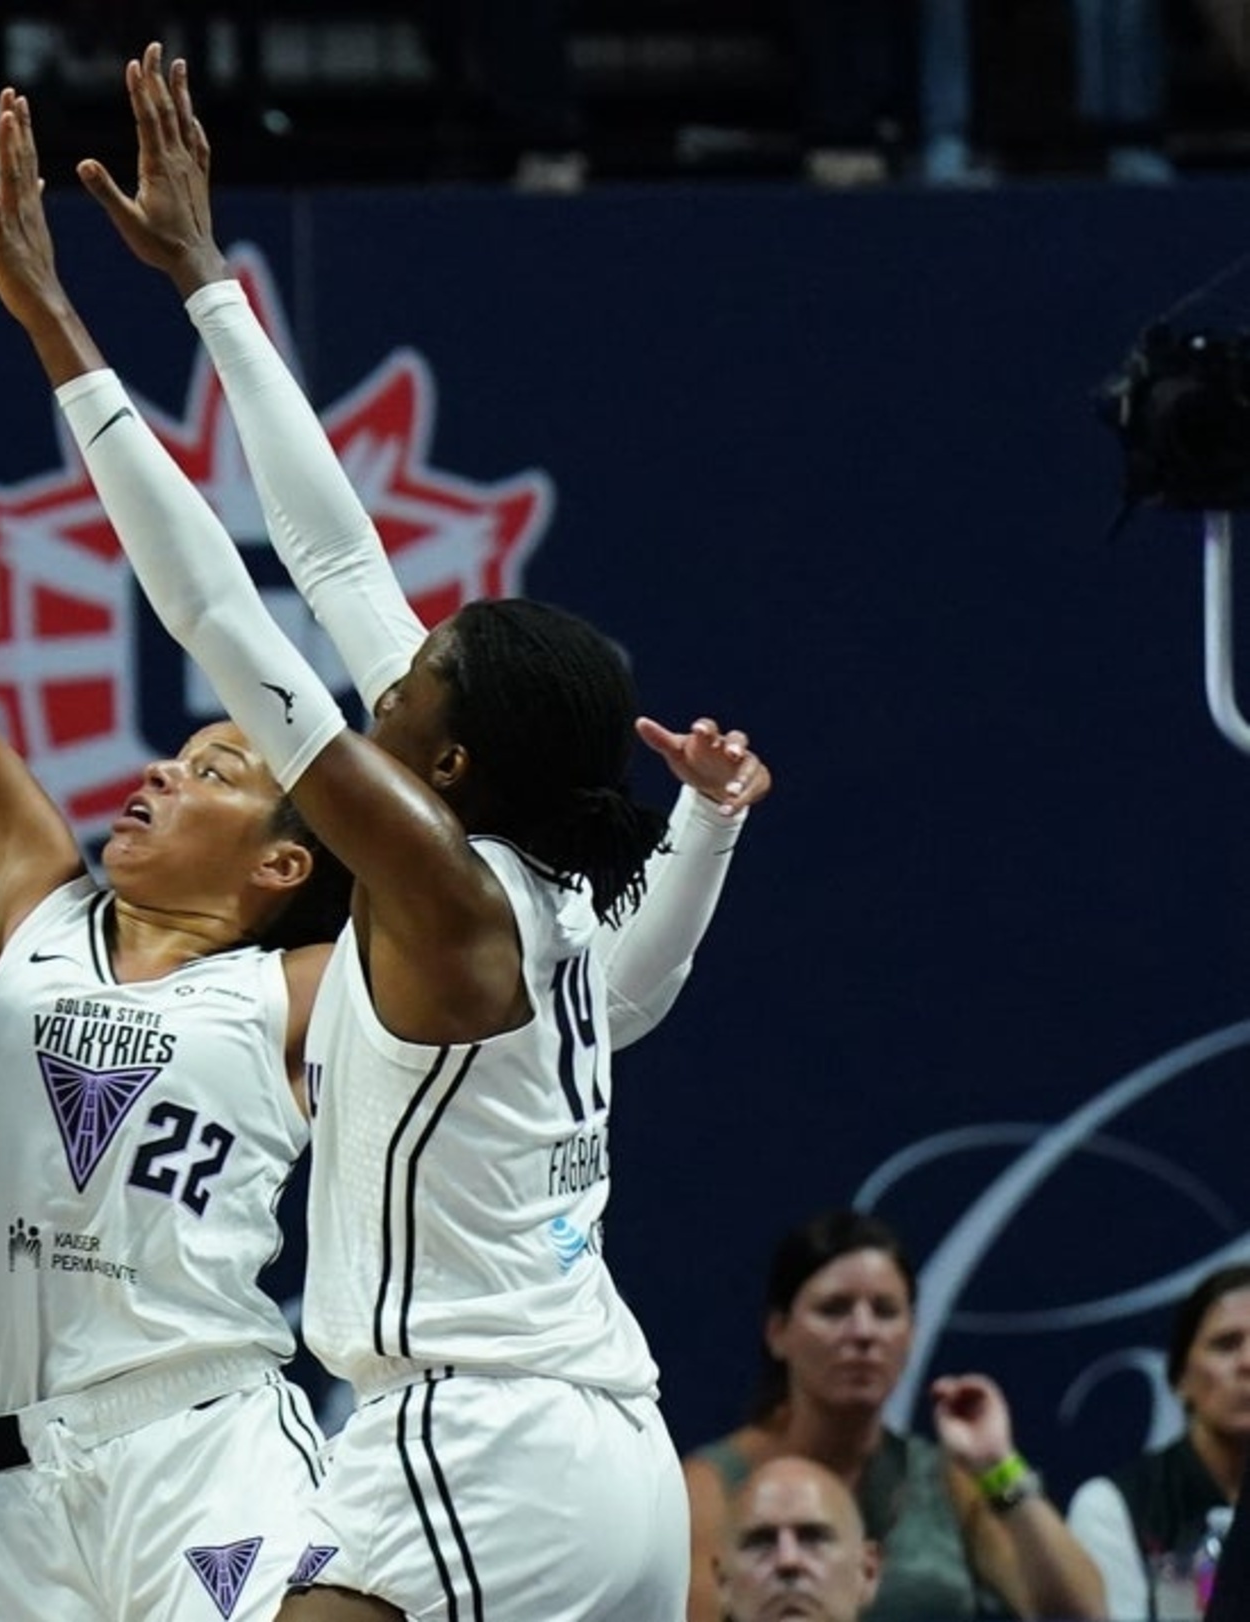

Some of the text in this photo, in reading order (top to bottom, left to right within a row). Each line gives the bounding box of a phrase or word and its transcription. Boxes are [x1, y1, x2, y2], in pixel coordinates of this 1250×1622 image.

[54, 998, 163, 1029] GOLDEN STATE
[33, 1013, 177, 1069] VALKYRIES
[127, 1100, 236, 1218] 22
[53, 1231, 101, 1252] KAISER
